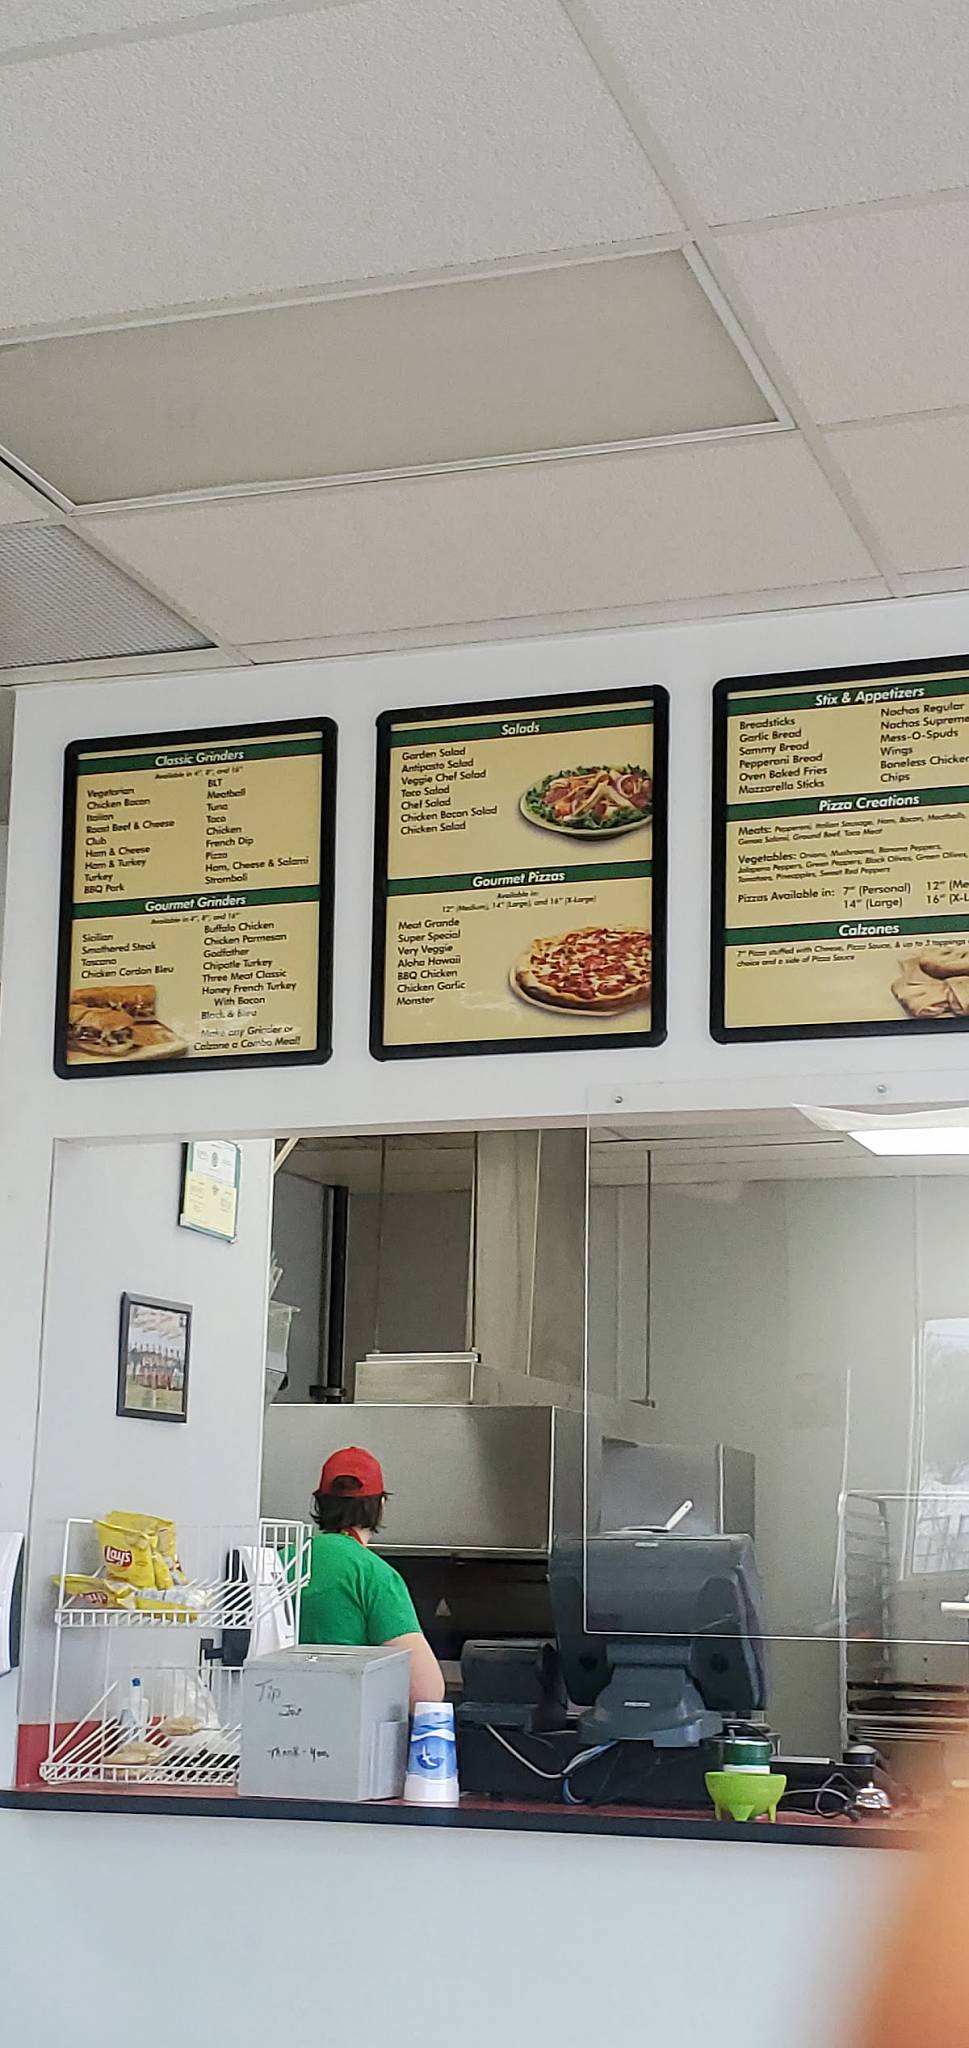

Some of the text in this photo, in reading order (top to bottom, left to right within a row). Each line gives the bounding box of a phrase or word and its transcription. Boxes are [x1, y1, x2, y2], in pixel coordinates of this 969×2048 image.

[816, 688, 924, 706] Stix & Appetizers
[881, 702, 964, 717] Nachos Regular
[501, 722, 540, 736] Salads
[740, 717, 795, 729] Breadsticks
[881, 716, 969, 730] Nachos Supreme
[740, 728, 801, 742] Garlic Bread
[881, 728, 958, 742] Mess-O-Spuds
[402, 747, 465, 760] Garden Salad
[739, 740, 809, 756] Sammy Bread
[880, 747, 913, 756] Wings
[155, 750, 244, 766] Classic Grinders
[740, 752, 822, 769] Pepperoni Bread
[881, 758, 926, 769] Boneless
[402, 759, 473, 772] Antipasto Salad
[402, 770, 486, 785] Veggie Chef Salad
[740, 767, 827, 781] Oven Baked Fries
[881, 772, 910, 782] Chips
[208, 779, 222, 787] BLT
[739, 779, 824, 794] Mozzarella Sticks
[88, 788, 134, 798] Vegetarian
[208, 788, 245, 799] Meatball
[401, 786, 449, 797] Taco Salad
[87, 800, 121, 809] Chicken
[401, 798, 450, 810] Chef Salad
[819, 794, 920, 811] Pizza Creations
[401, 806, 497, 822] Chicken Bacon Salad
[112, 822, 131, 831] Beef
[134, 821, 139, 829] &
[143, 820, 175, 828] Cheese
[207, 826, 241, 835] Chicken
[401, 821, 465, 834] Chicken Salad
[739, 826, 771, 835] Meats:
[86, 837, 106, 846] Club
[206, 836, 253, 848] French Dip
[109, 848, 115, 856] &
[119, 847, 150, 855] Cheese
[206, 852, 228, 860] Pizza
[109, 860, 114, 868] &
[118, 858, 146, 868] Turkey
[206, 856, 308, 872] Ham, Cheese & Salami
[738, 852, 796, 865] Vegetables:
[85, 873, 113, 882] Turkey
[205, 874, 247, 884] Stromboli
[473, 871, 565, 887] Gourmet Pizzas
[84, 885, 102, 894] BBQ
[927, 881, 946, 890] 12"
[738, 882, 910, 903] Pizzas Available in: 7" (Personal)
[145, 897, 246, 912] Gourmet Grinders
[844, 897, 902, 909] 14" (Large)
[927, 894, 946, 904] 16"
[205, 922, 274, 933] Buffalo Chicken
[398, 917, 460, 930] Meat Grande
[838, 924, 900, 936] Calzones
[83, 934, 113, 942] Sicilian
[204, 934, 286, 945] Chicken Parmesan
[398, 930, 460, 943] Super Special
[82, 942, 156, 954] Smothered Steak
[204, 947, 248, 958] Godfather
[398, 944, 453, 956] Very Veggie
[203, 959, 272, 971] Chipotle Turkey
[398, 956, 461, 968] Aloha Hawaii
[82, 965, 173, 978] Chicken Cordon Bleu
[203, 969, 286, 982] Three Meat Classic
[398, 969, 457, 980] BBQ Chicken
[202, 982, 296, 995] Honey French Turkey
[397, 981, 465, 993] Chicken Garlic
[214, 997, 234, 1006] With
[397, 997, 434, 1005] Monster
[248, 1024, 282, 1035] Grinder
[194, 1041, 229, 1050] Calzone
[241, 1038, 271, 1047] Combo
[256, 1679, 281, 1703] Tip
